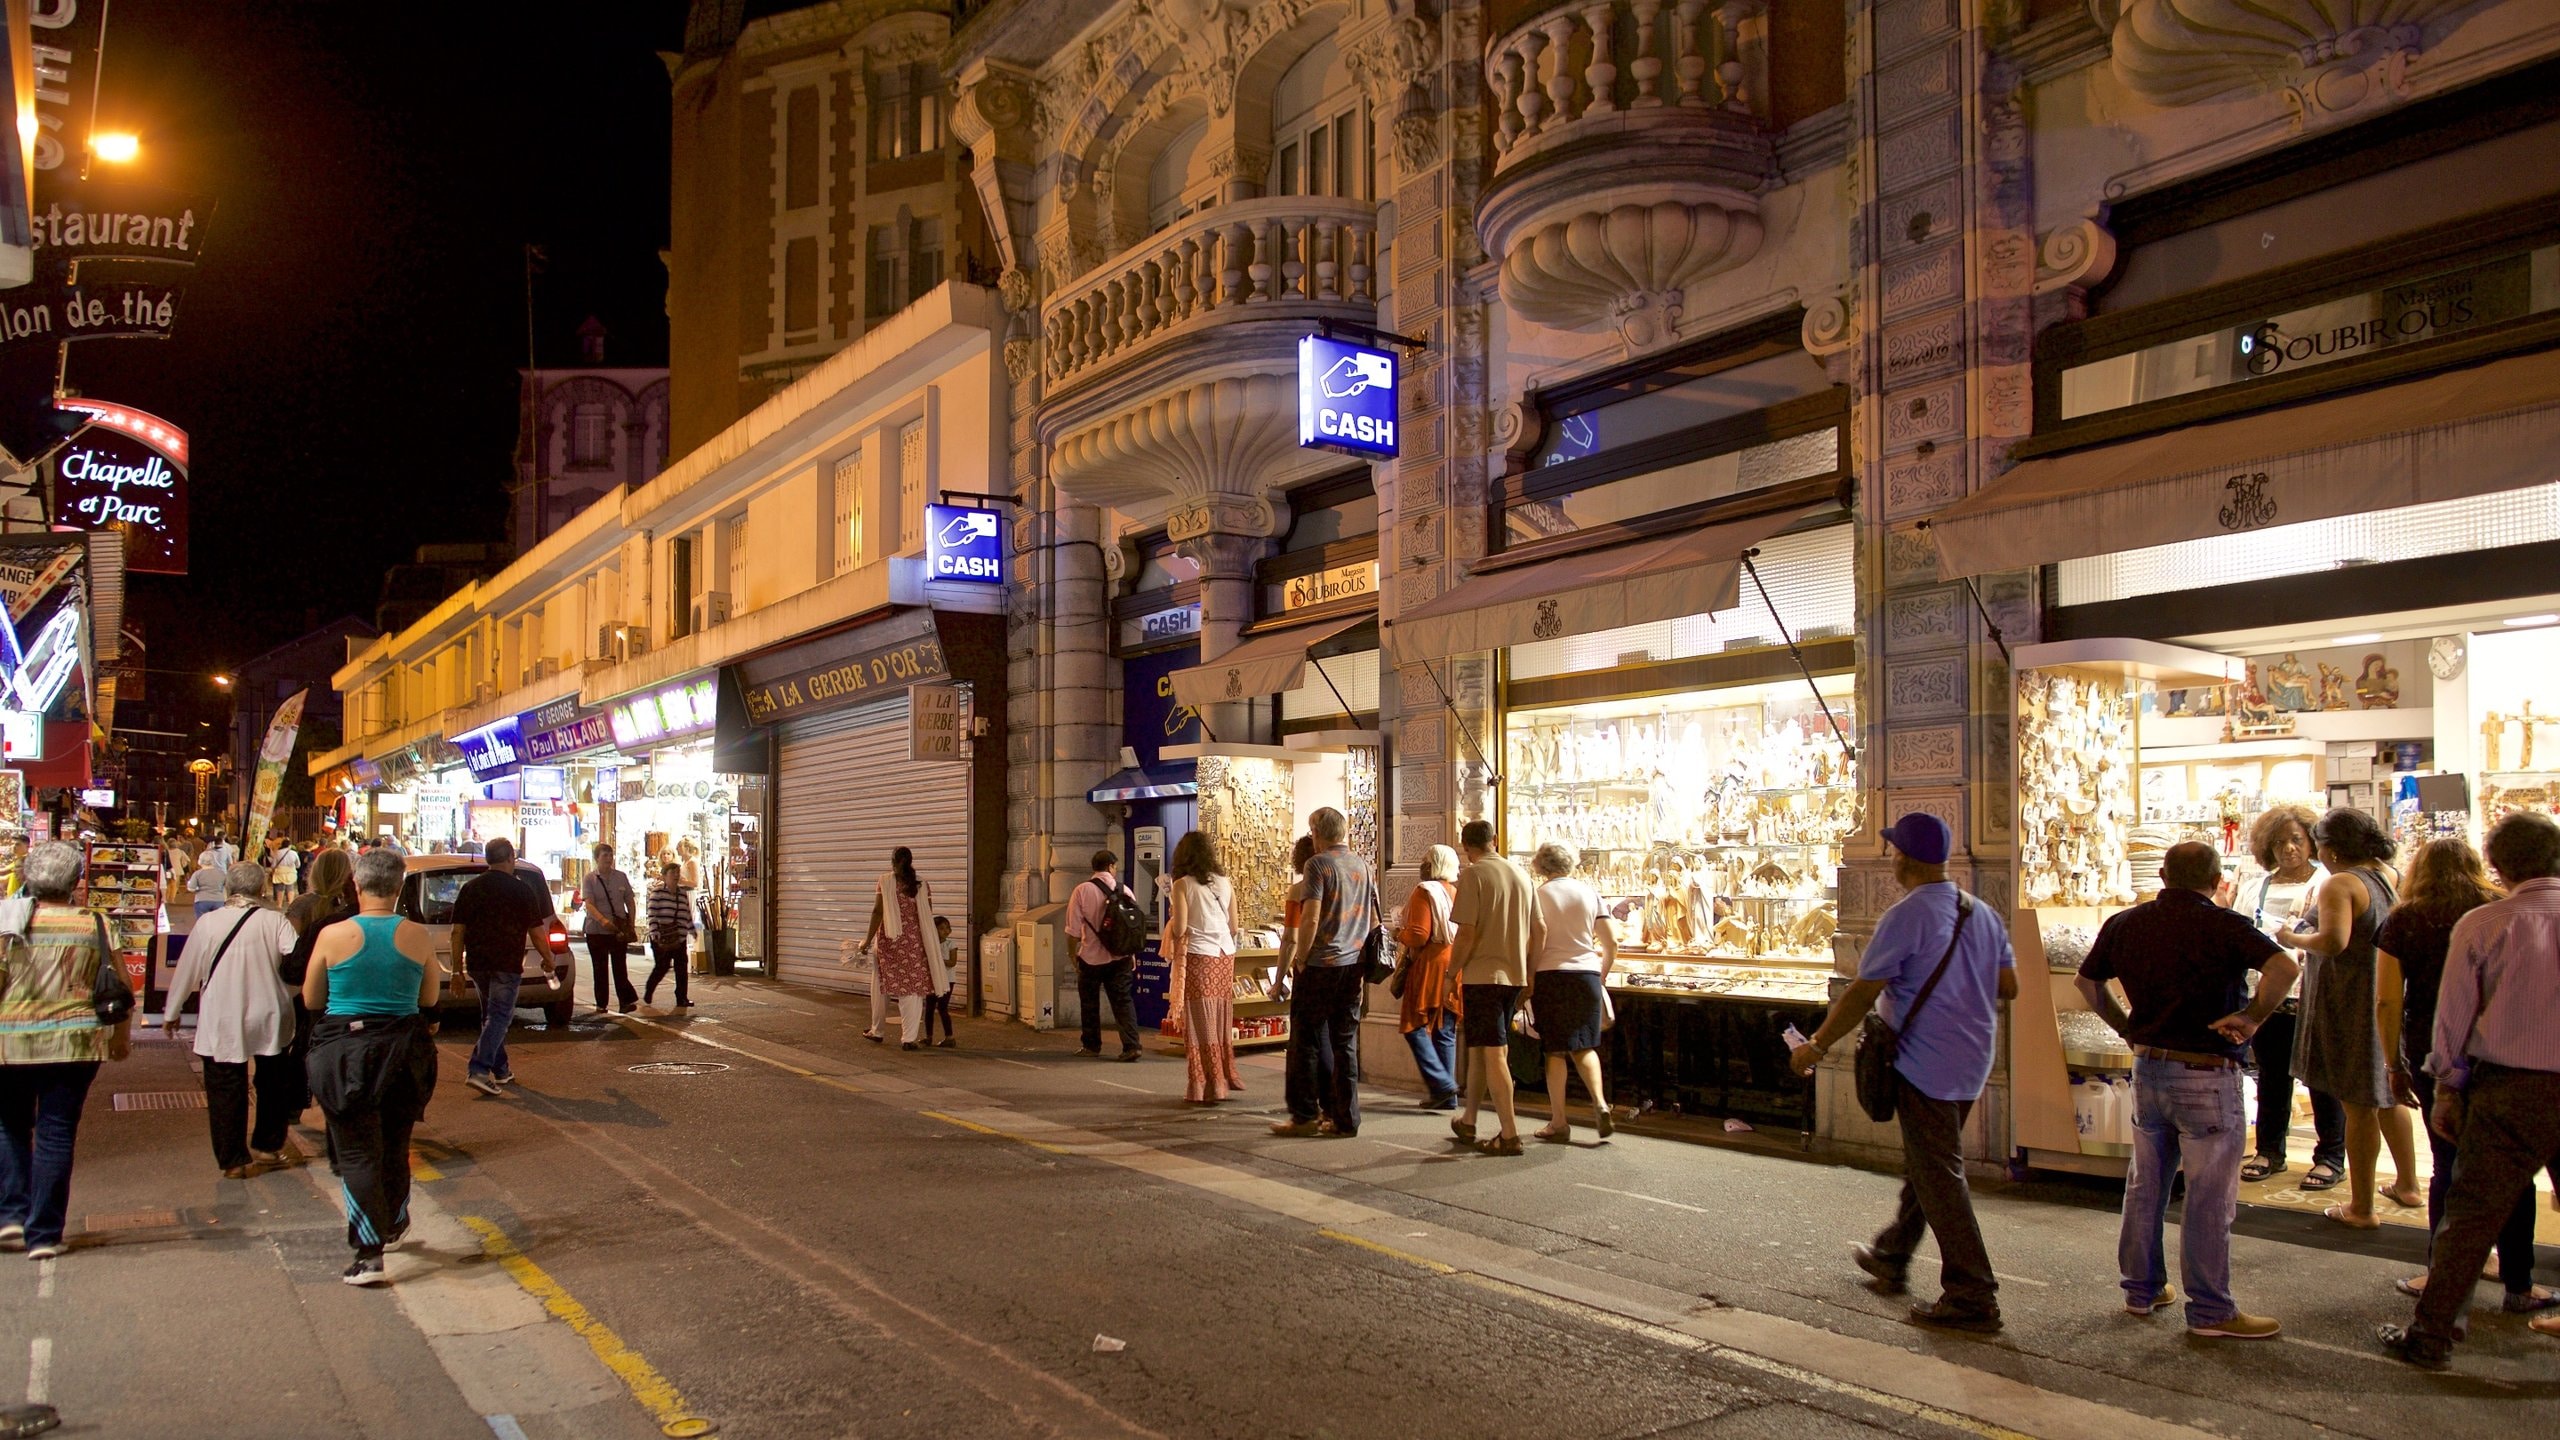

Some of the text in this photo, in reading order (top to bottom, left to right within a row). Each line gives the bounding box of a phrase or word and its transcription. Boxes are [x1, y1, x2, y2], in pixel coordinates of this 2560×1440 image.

[32, 202, 195, 251] staurant
[2396, 278, 2474, 306] Magasin
[0, 290, 174, 343] lon de thé
[1319, 408, 1394, 447] CASH
[62, 449, 174, 491] Chapelle
[78, 495, 161, 525] et Parc
[0, 566, 34, 586] ANGE
[938, 555, 999, 578] CASH
[1341, 567, 1366, 579] Magasin
[1293, 576, 1366, 607] SOUBIROUS
[1147, 610, 1191, 635] CASH
[764, 688, 778, 713] A
[779, 681, 804, 707] LA
[808, 663, 868, 701] GERBE
[871, 648, 921, 686] D'OR
[547, 701, 575, 726] GEORGE
[922, 693, 951, 709] A LA
[919, 712, 955, 731] GERBE
[531, 732, 555, 756] Paul
[521, 807, 551, 816] DEUTSC
[1138, 834, 1152, 842] CASH
